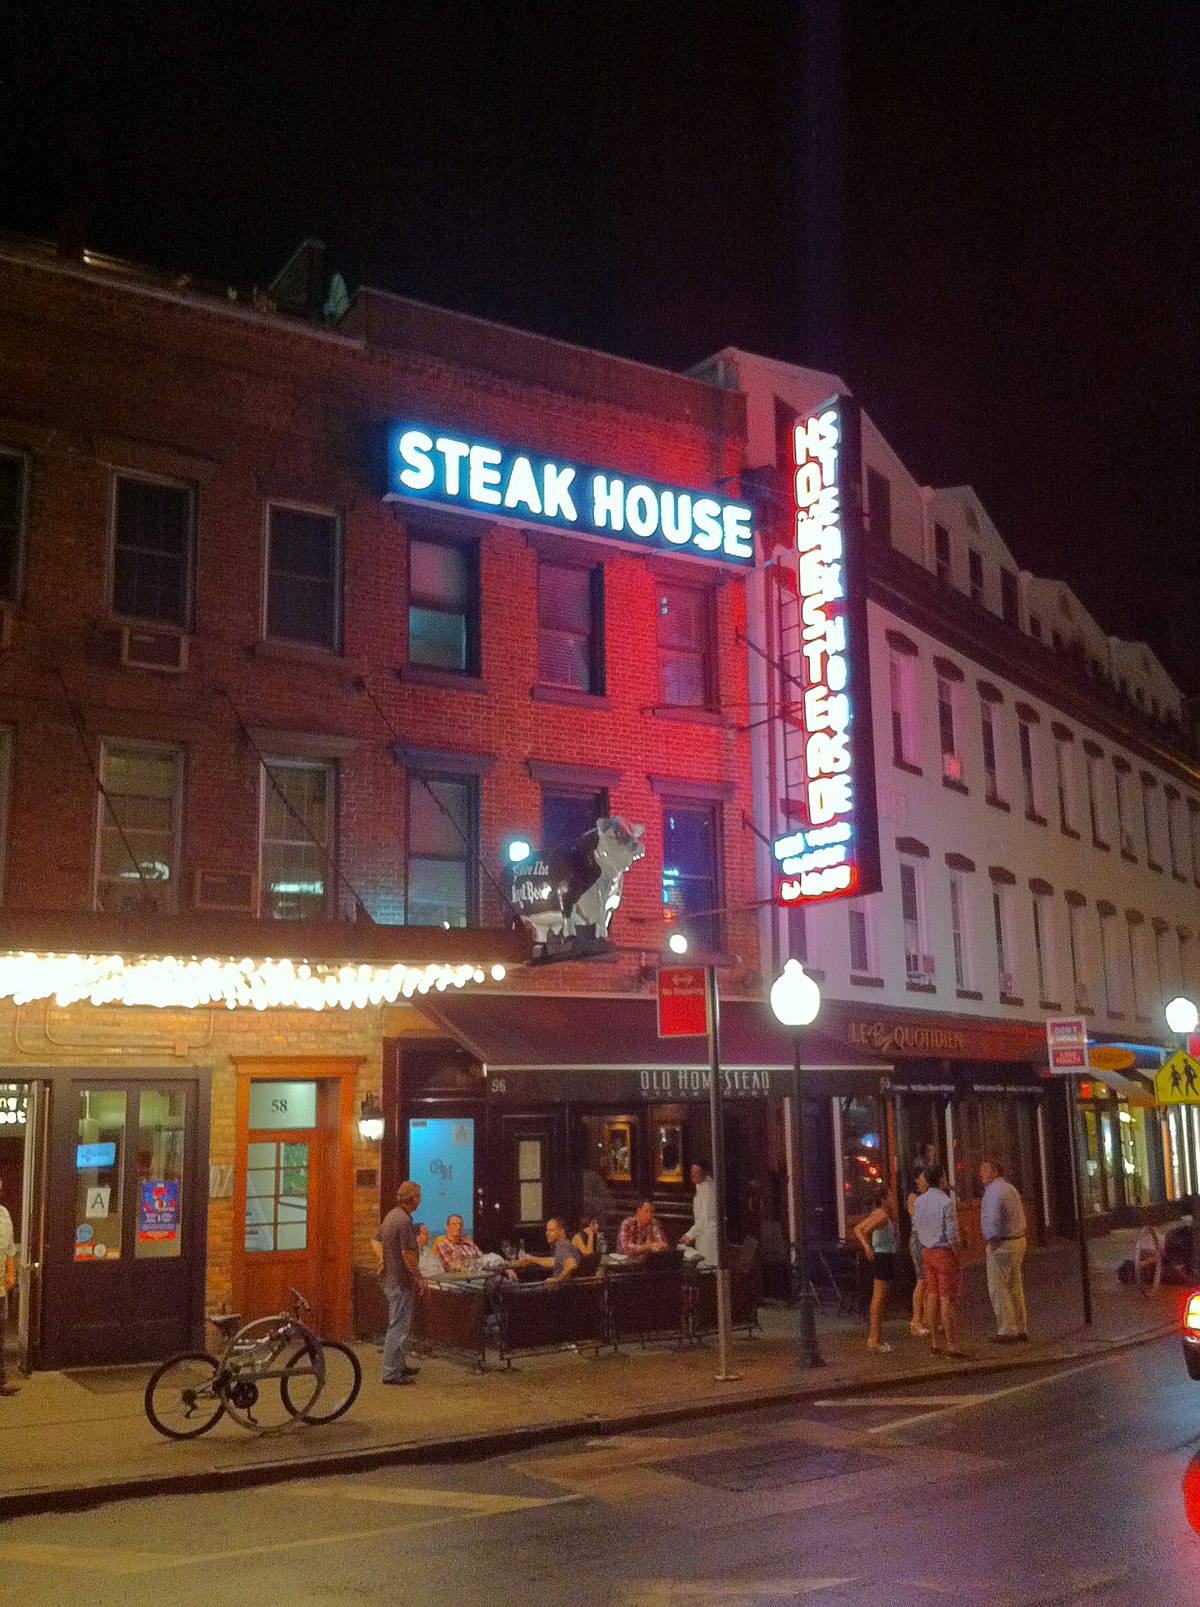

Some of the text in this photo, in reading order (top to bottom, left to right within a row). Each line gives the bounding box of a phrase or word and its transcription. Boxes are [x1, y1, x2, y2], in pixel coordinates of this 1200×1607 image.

[400, 431, 753, 558] STEAK HOUSE
[640, 1070, 770, 1090] OLD HOMSTEAD
[271, 1099, 288, 1112] 58
[92, 1193, 105, 1209] A
